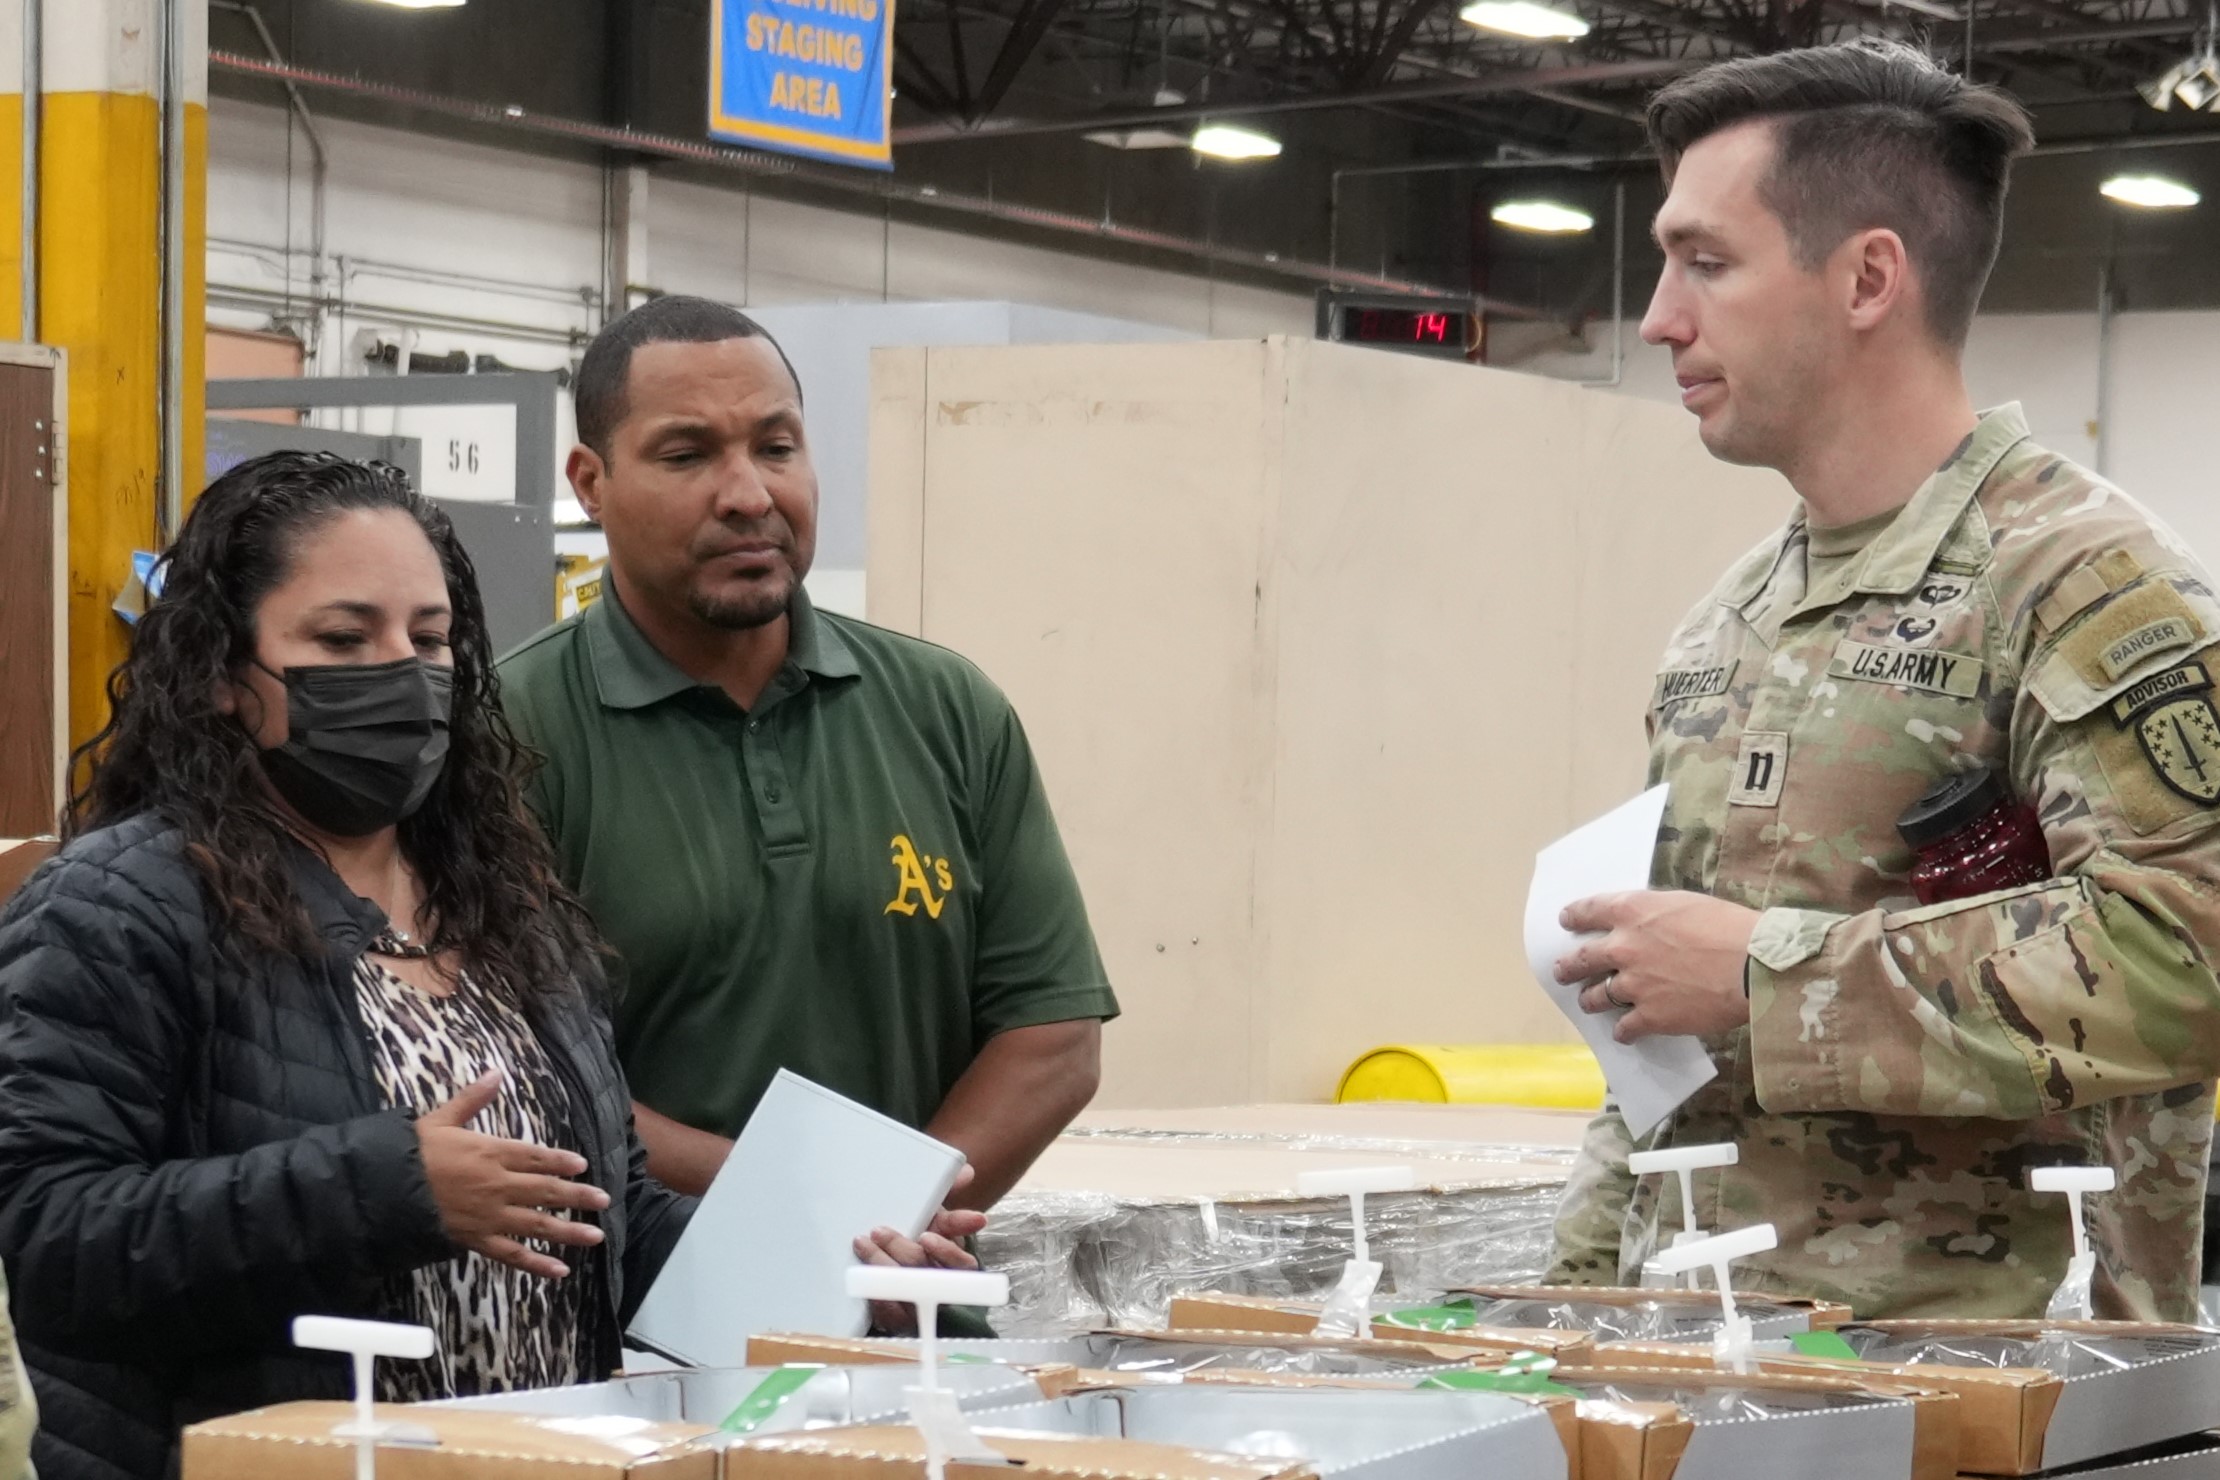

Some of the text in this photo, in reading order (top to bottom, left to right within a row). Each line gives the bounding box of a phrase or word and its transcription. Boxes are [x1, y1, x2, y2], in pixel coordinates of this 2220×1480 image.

[746, 13, 864, 72] STAGING
[770, 72, 841, 120] AREA
[1415, 313, 1447, 343] 14
[449, 440, 479, 474] 56
[2109, 624, 2178, 666] RANGER
[2126, 670, 2190, 709] ADVISOR
[883, 835, 953, 919] A's
